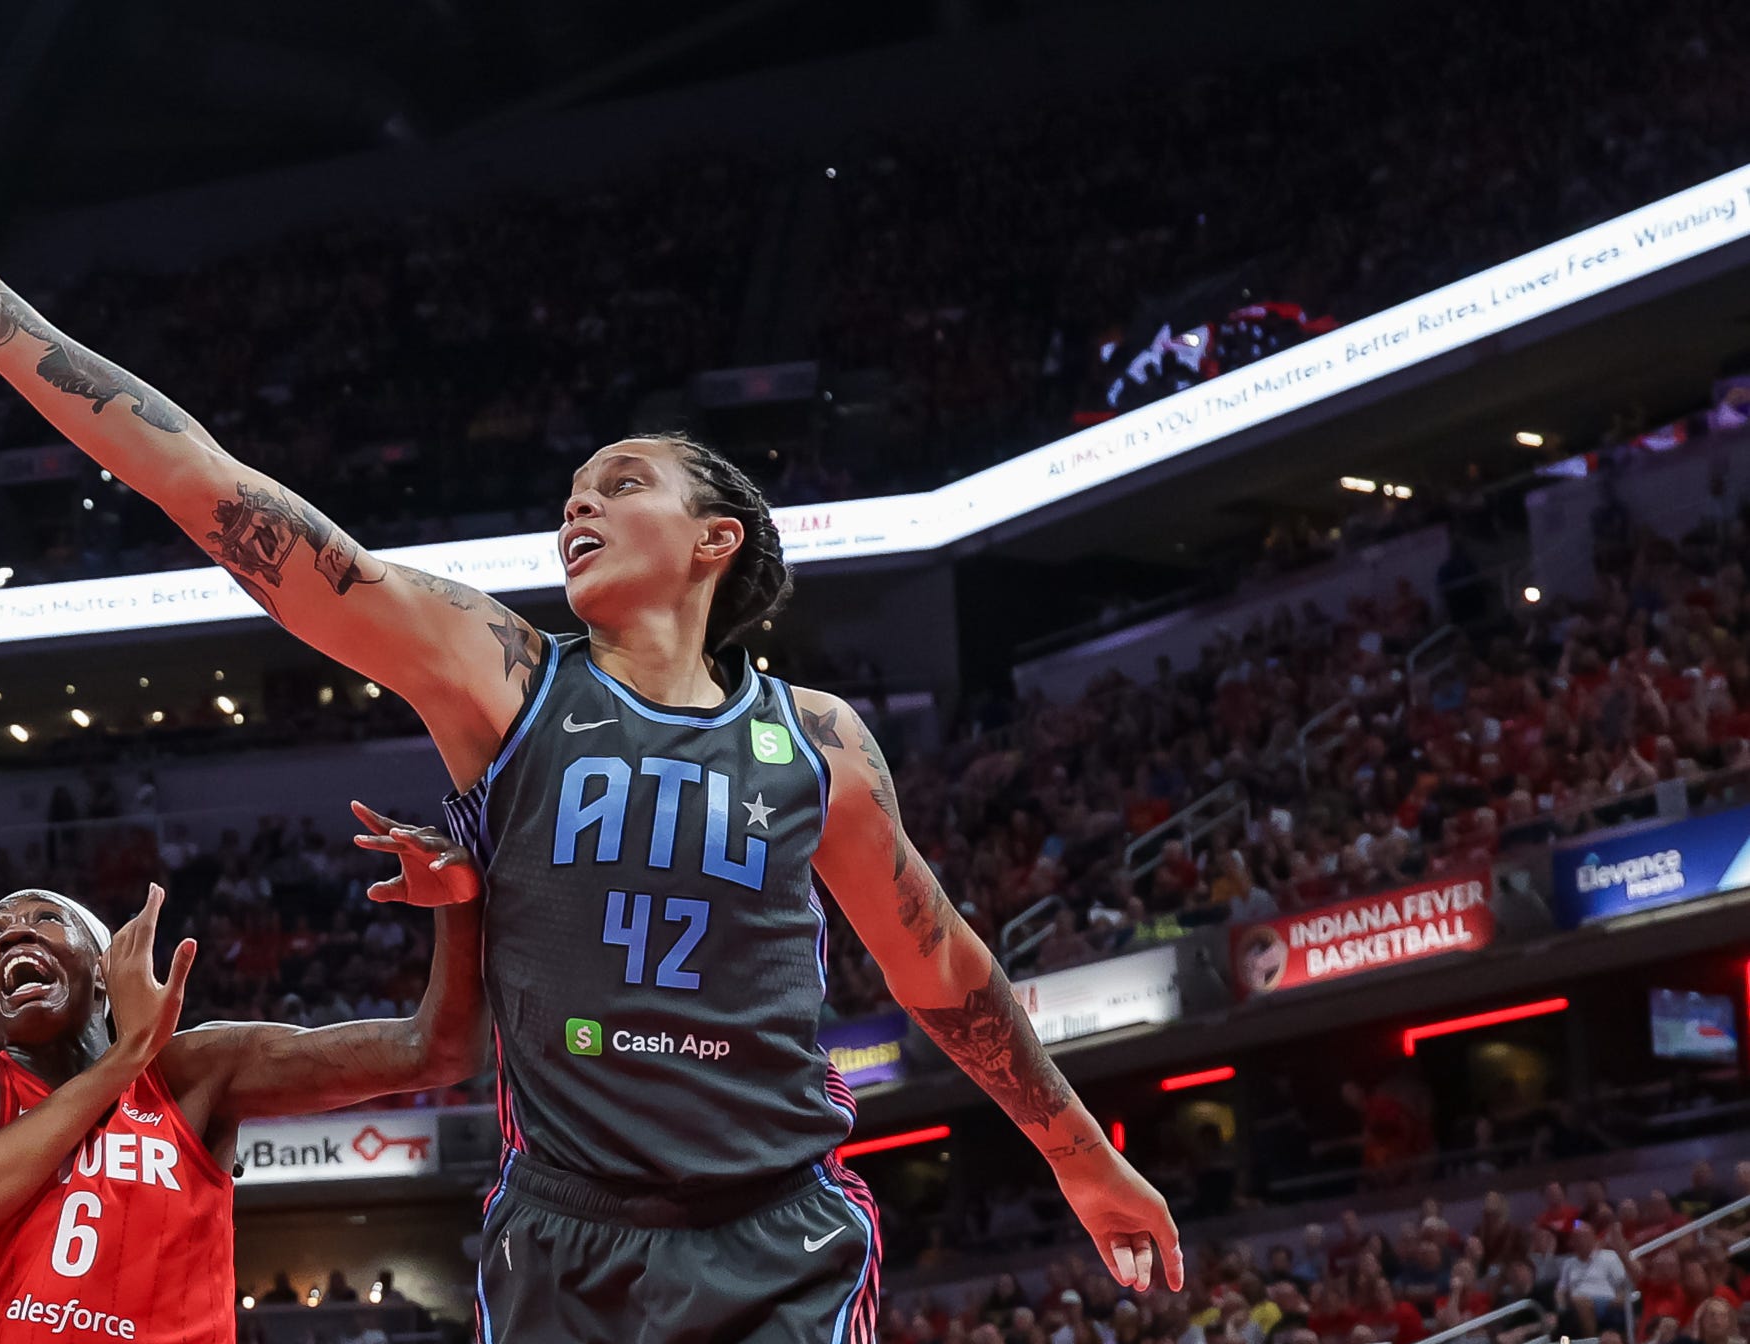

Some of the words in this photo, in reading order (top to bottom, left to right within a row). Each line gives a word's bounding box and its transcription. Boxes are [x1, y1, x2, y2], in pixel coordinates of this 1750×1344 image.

[1344, 326, 1410, 365] Better
[1490, 265, 1560, 308] Lower
[1633, 195, 1738, 250] Winning
[552, 756, 768, 891] ATL
[602, 890, 711, 990] 42
[1288, 900, 1402, 950] INDIANA
[1401, 879, 1487, 927] FEVER
[1306, 917, 1472, 979] BASKETBALL
[612, 1029, 675, 1054] Cash
[679, 1033, 731, 1060] App
[51, 1190, 102, 1278] 6
[6, 1293, 136, 1340] alesforce
